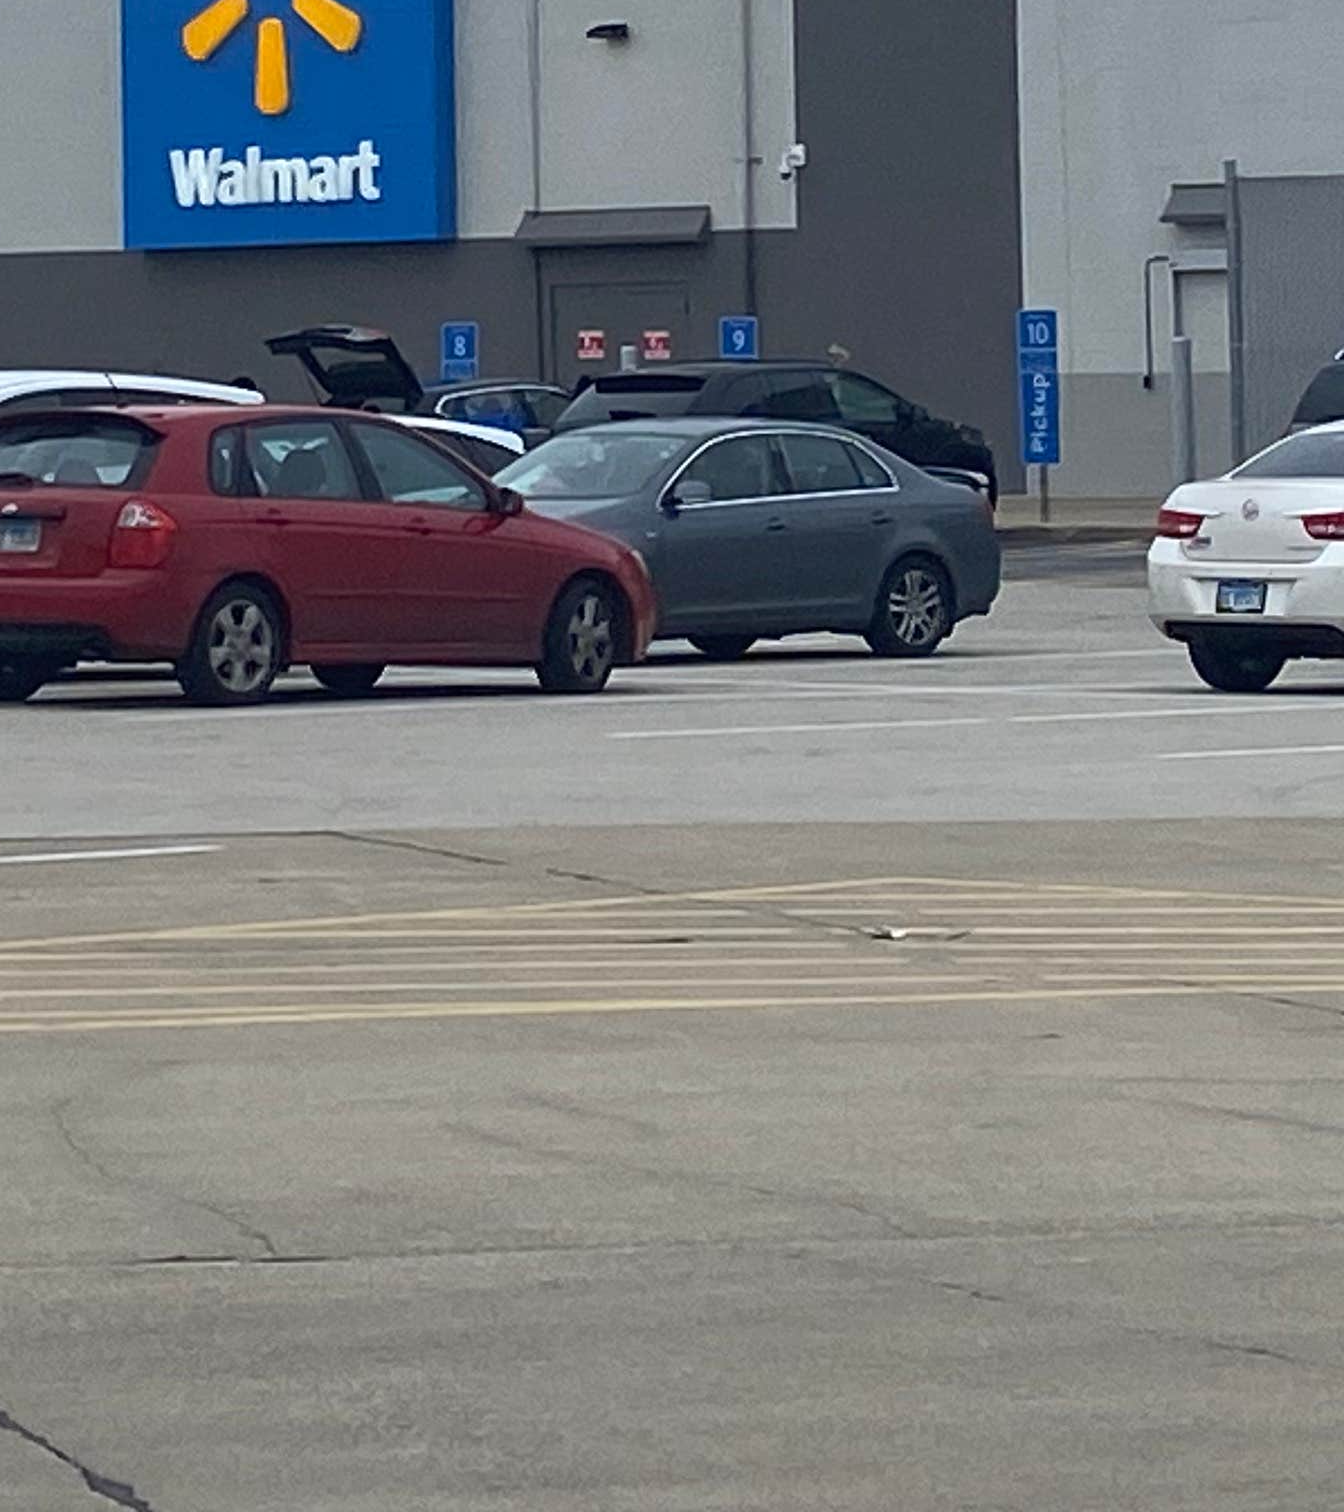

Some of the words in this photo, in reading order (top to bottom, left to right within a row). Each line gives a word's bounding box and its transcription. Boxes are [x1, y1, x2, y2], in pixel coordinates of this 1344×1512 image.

[169, 139, 381, 208] Walmart
[732, 329, 745, 351] 9
[1027, 321, 1049, 345] 10
[454, 334, 466, 357] 8
[1029, 373, 1051, 453] Pickup
